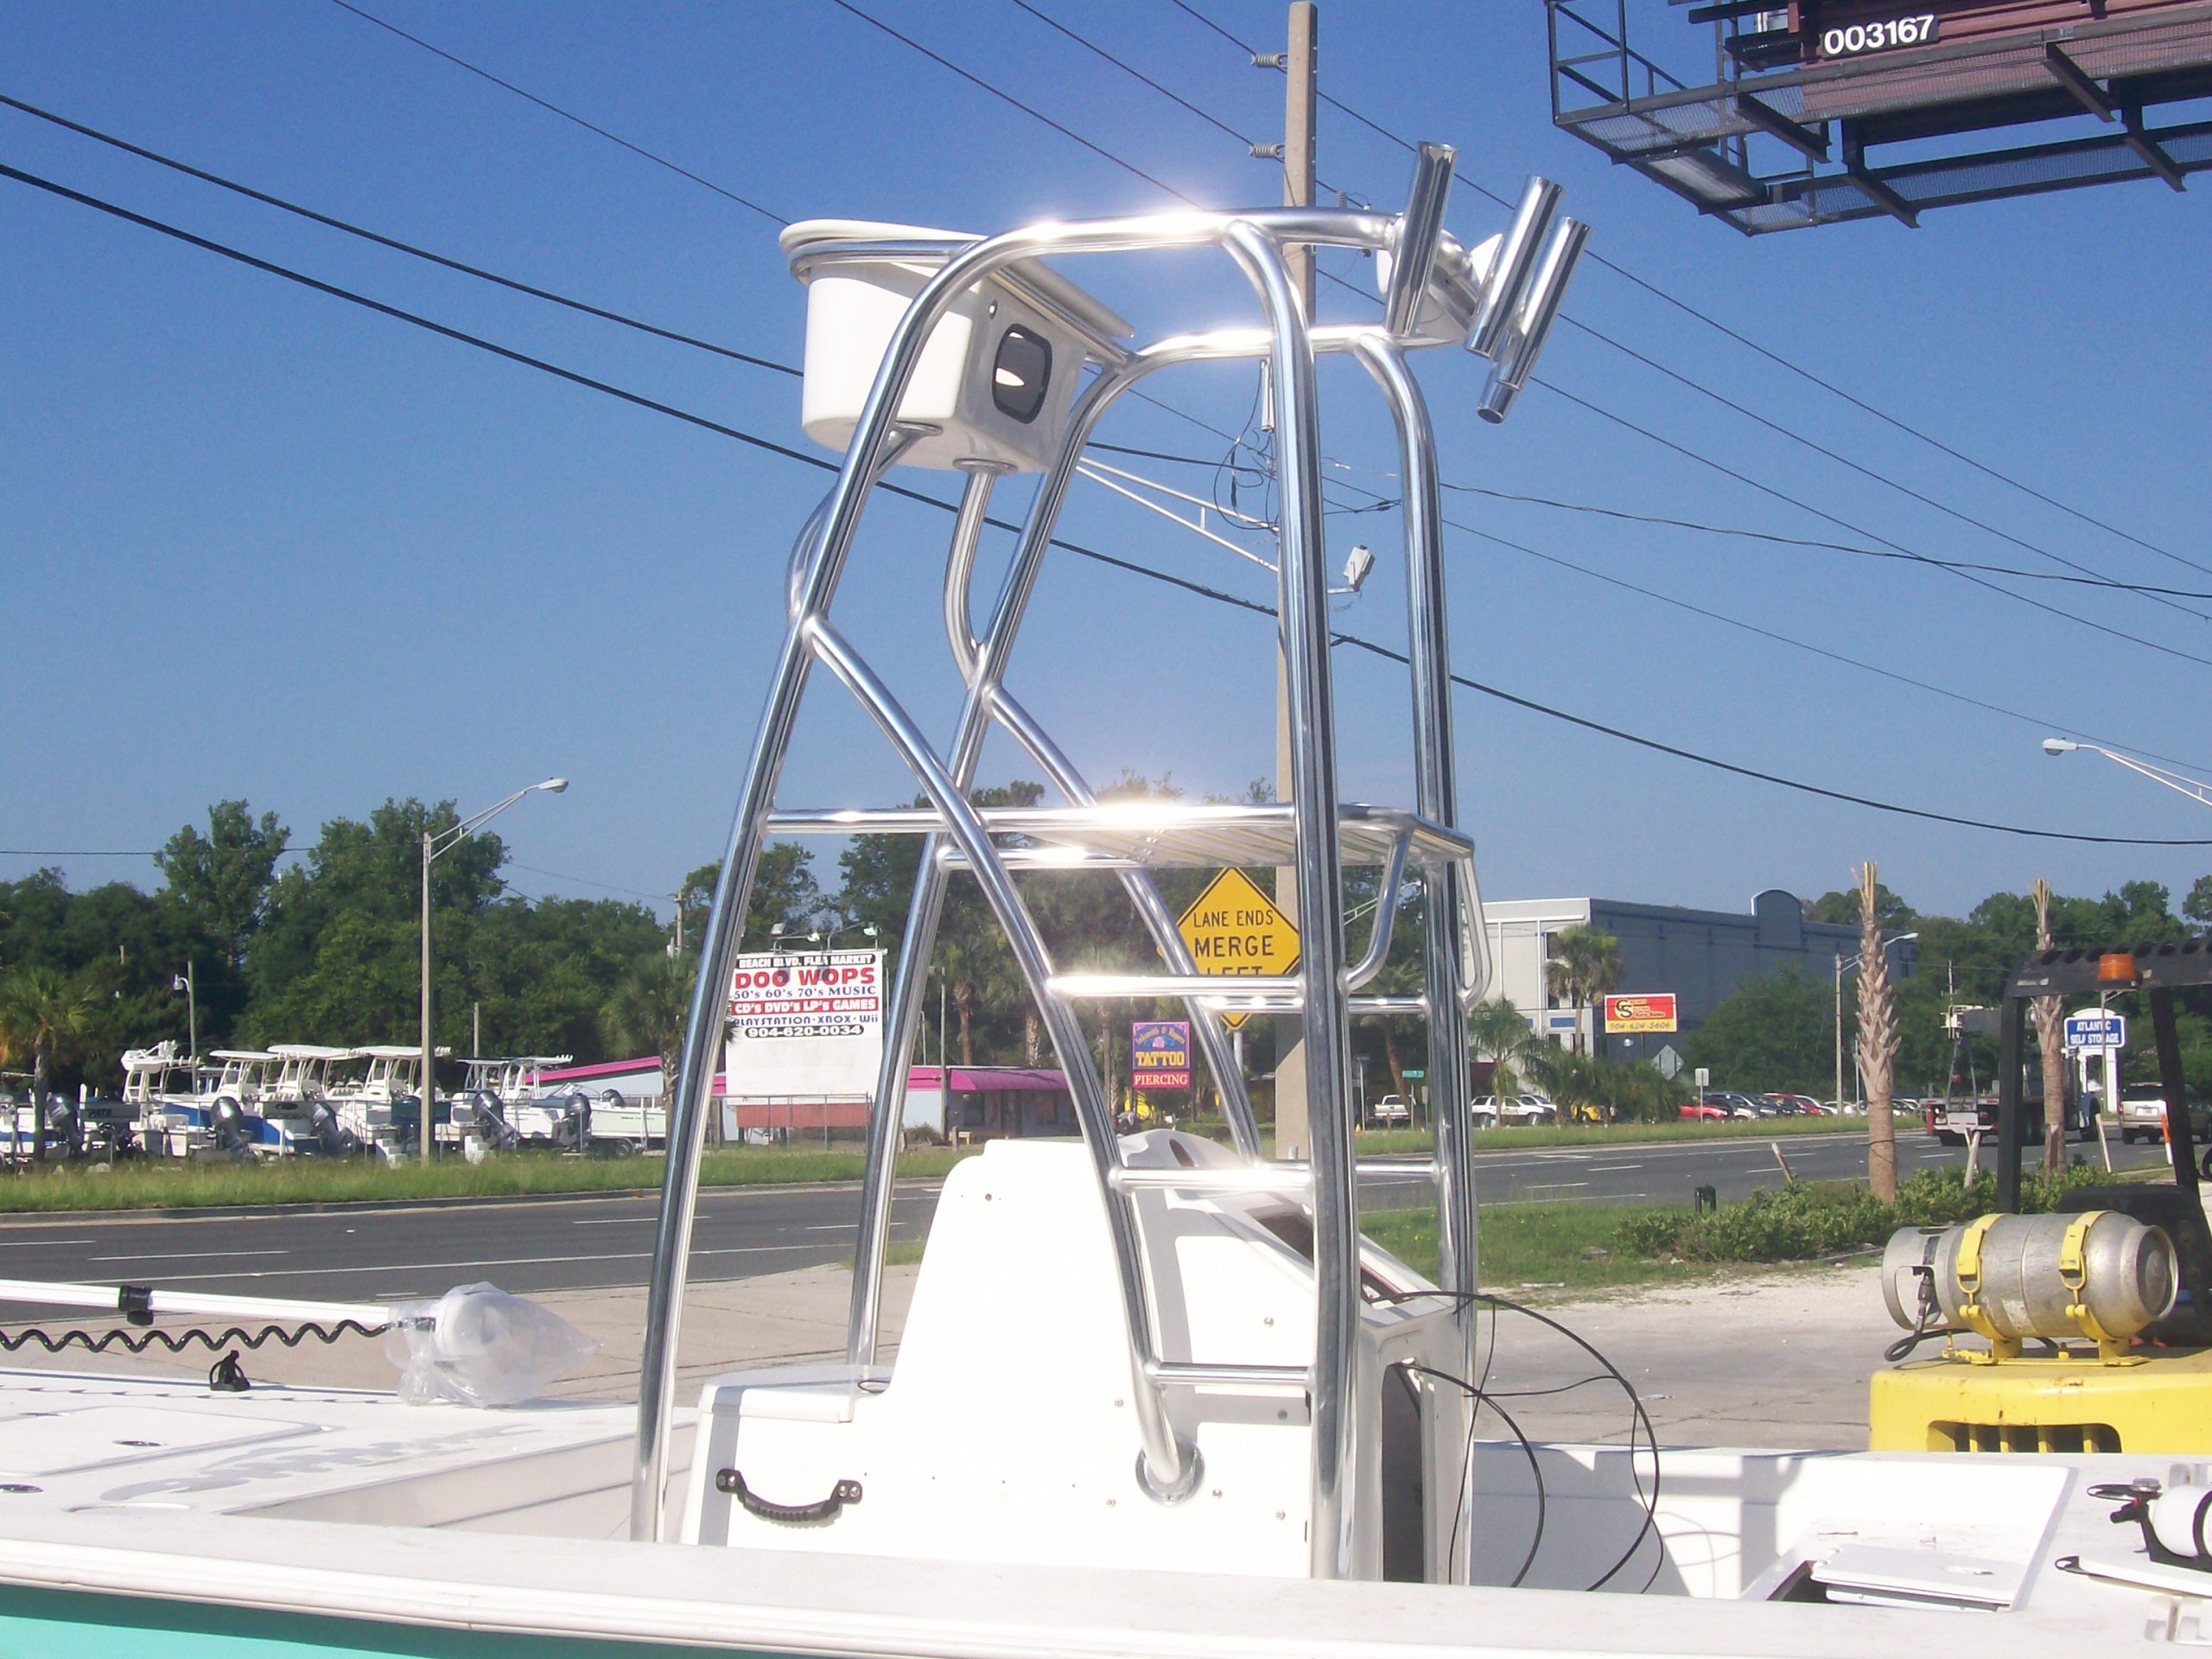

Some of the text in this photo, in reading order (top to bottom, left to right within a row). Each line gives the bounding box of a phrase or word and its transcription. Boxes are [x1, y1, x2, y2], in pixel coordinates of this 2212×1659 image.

[1824, 14, 1935, 54] 003167
[1193, 909, 1274, 927] LANE ENDS
[1194, 935, 1274, 957] MERGE
[739, 954, 873, 968] BEACH BLVD. FLEA MARKET
[735, 967, 874, 989] DOO WOPS
[734, 986, 876, 1000] 50's 60's 70's MUSIC
[734, 999, 876, 1014] CD's DVD's LP's GAMES
[860, 1014, 878, 1023] Wii
[747, 1025, 861, 1038] 904-620-0034
[2076, 1020, 2112, 1032] ATLANTC
[2070, 1033, 2120, 1045] SELF STOAGE
[1135, 1051, 1185, 1066] TATTOO
[1135, 1074, 1188, 1085] PIERCING
